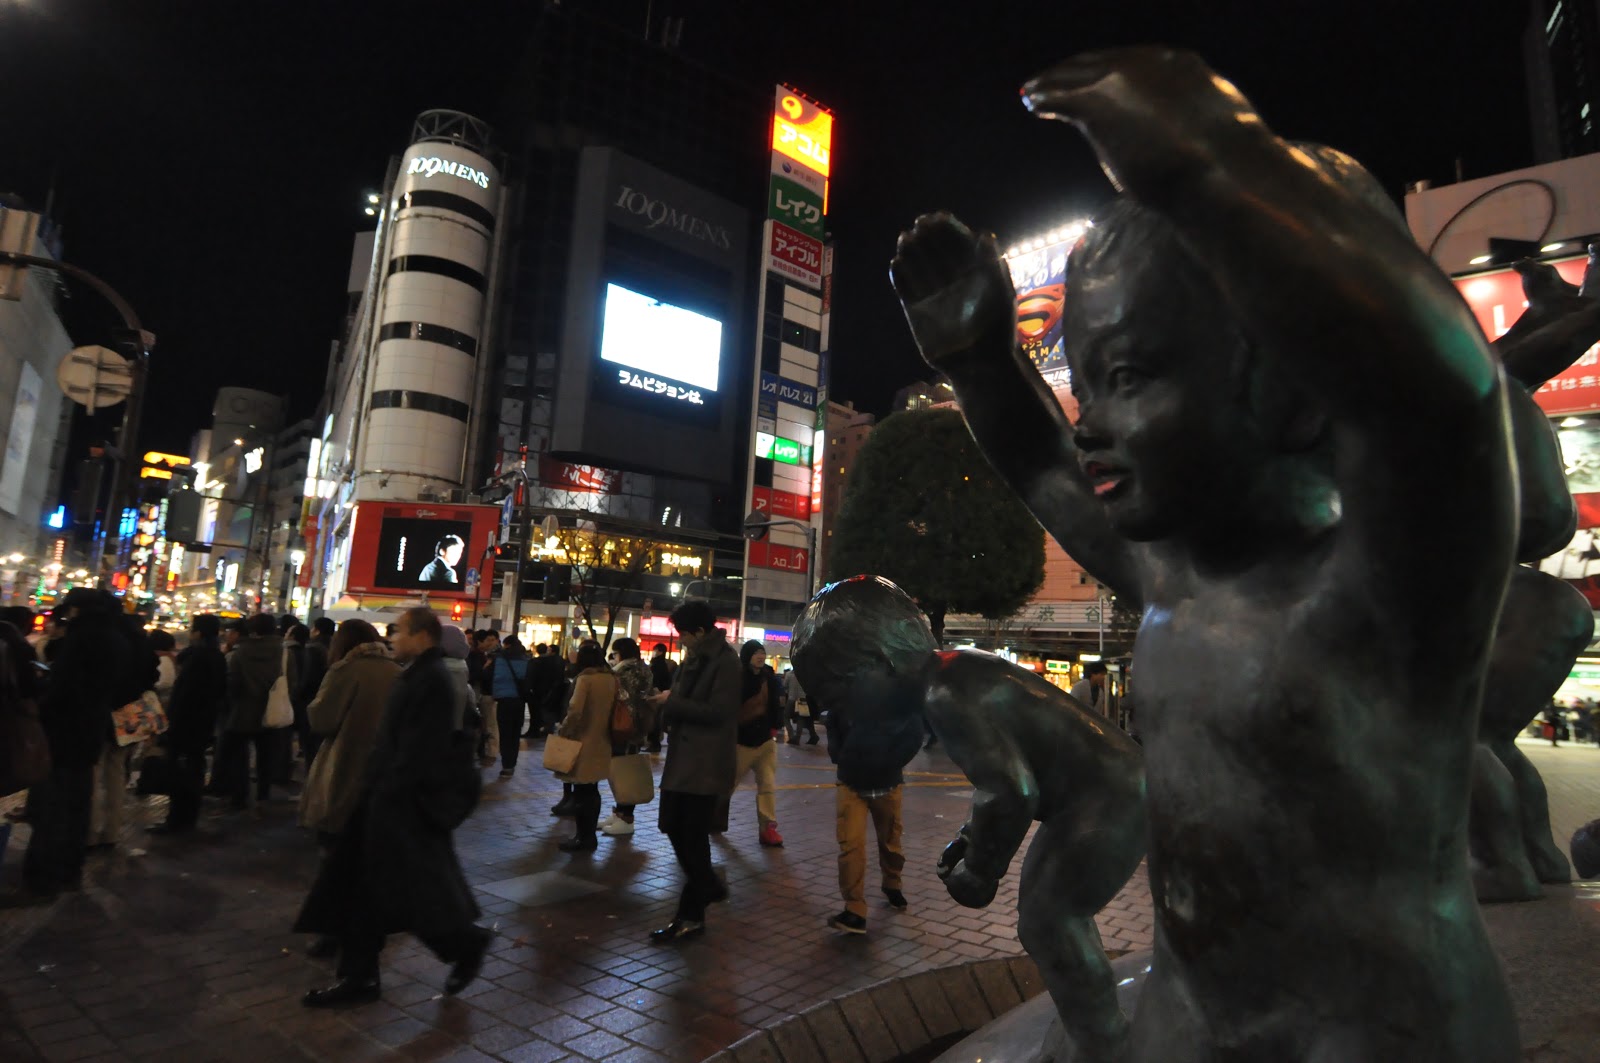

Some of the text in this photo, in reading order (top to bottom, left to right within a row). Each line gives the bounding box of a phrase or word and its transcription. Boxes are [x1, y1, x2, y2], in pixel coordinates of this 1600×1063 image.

[780, 124, 830, 165] アコム
[775, 188, 820, 224] レイク
[775, 236, 820, 268] アイフル
[772, 557, 787, 567] 入口
[1038, 605, 1100, 623] 渋谷
